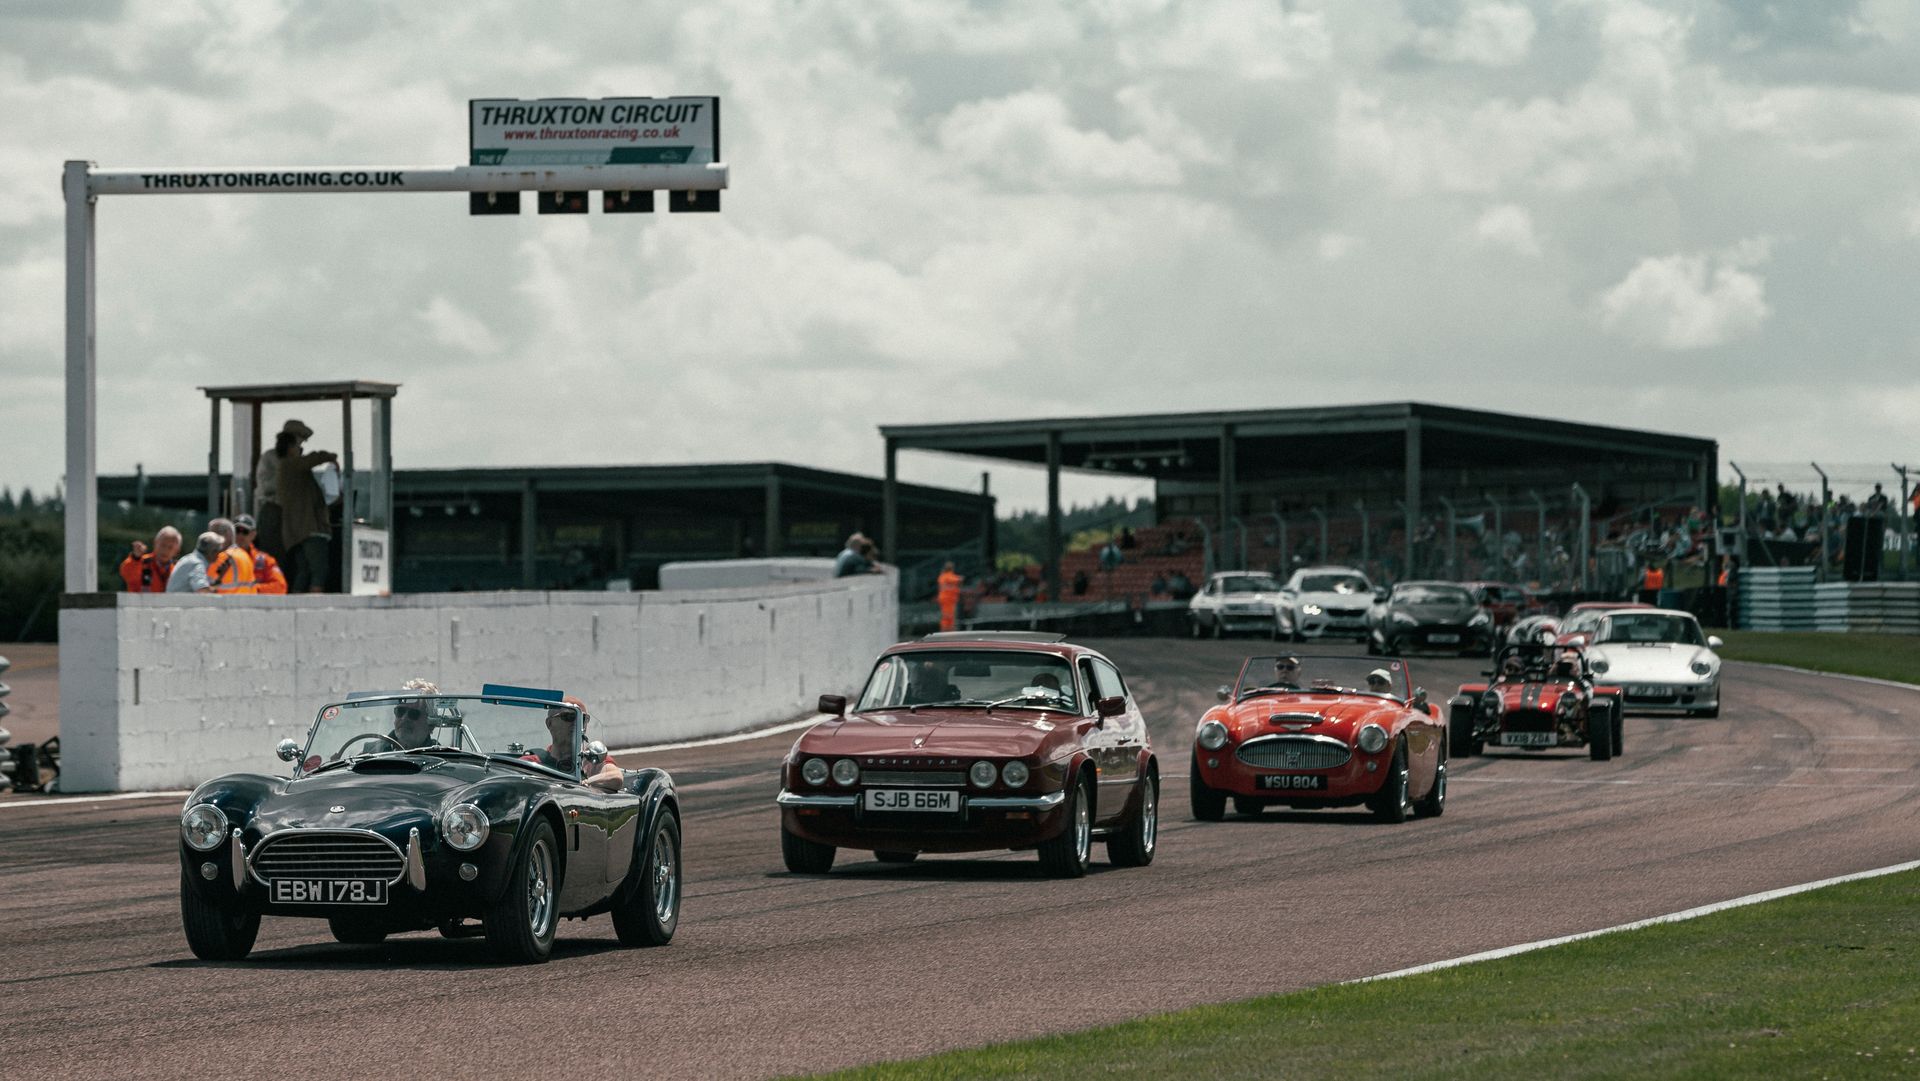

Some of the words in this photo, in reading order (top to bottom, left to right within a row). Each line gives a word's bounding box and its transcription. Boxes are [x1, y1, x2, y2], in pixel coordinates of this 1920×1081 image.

[481, 105, 604, 126] THRUXTON
[611, 103, 703, 124] CIRCUIT
[504, 125, 680, 142] www.thruxtonracing.co.uk
[141, 171, 404, 189] THRUXTONRACING.CO.UK
[1264, 775, 1290, 789] WSU
[874, 792, 910, 808] SJB
[914, 792, 951, 809] 66M
[277, 880, 322, 901] EBW
[329, 880, 380, 902] 178J
